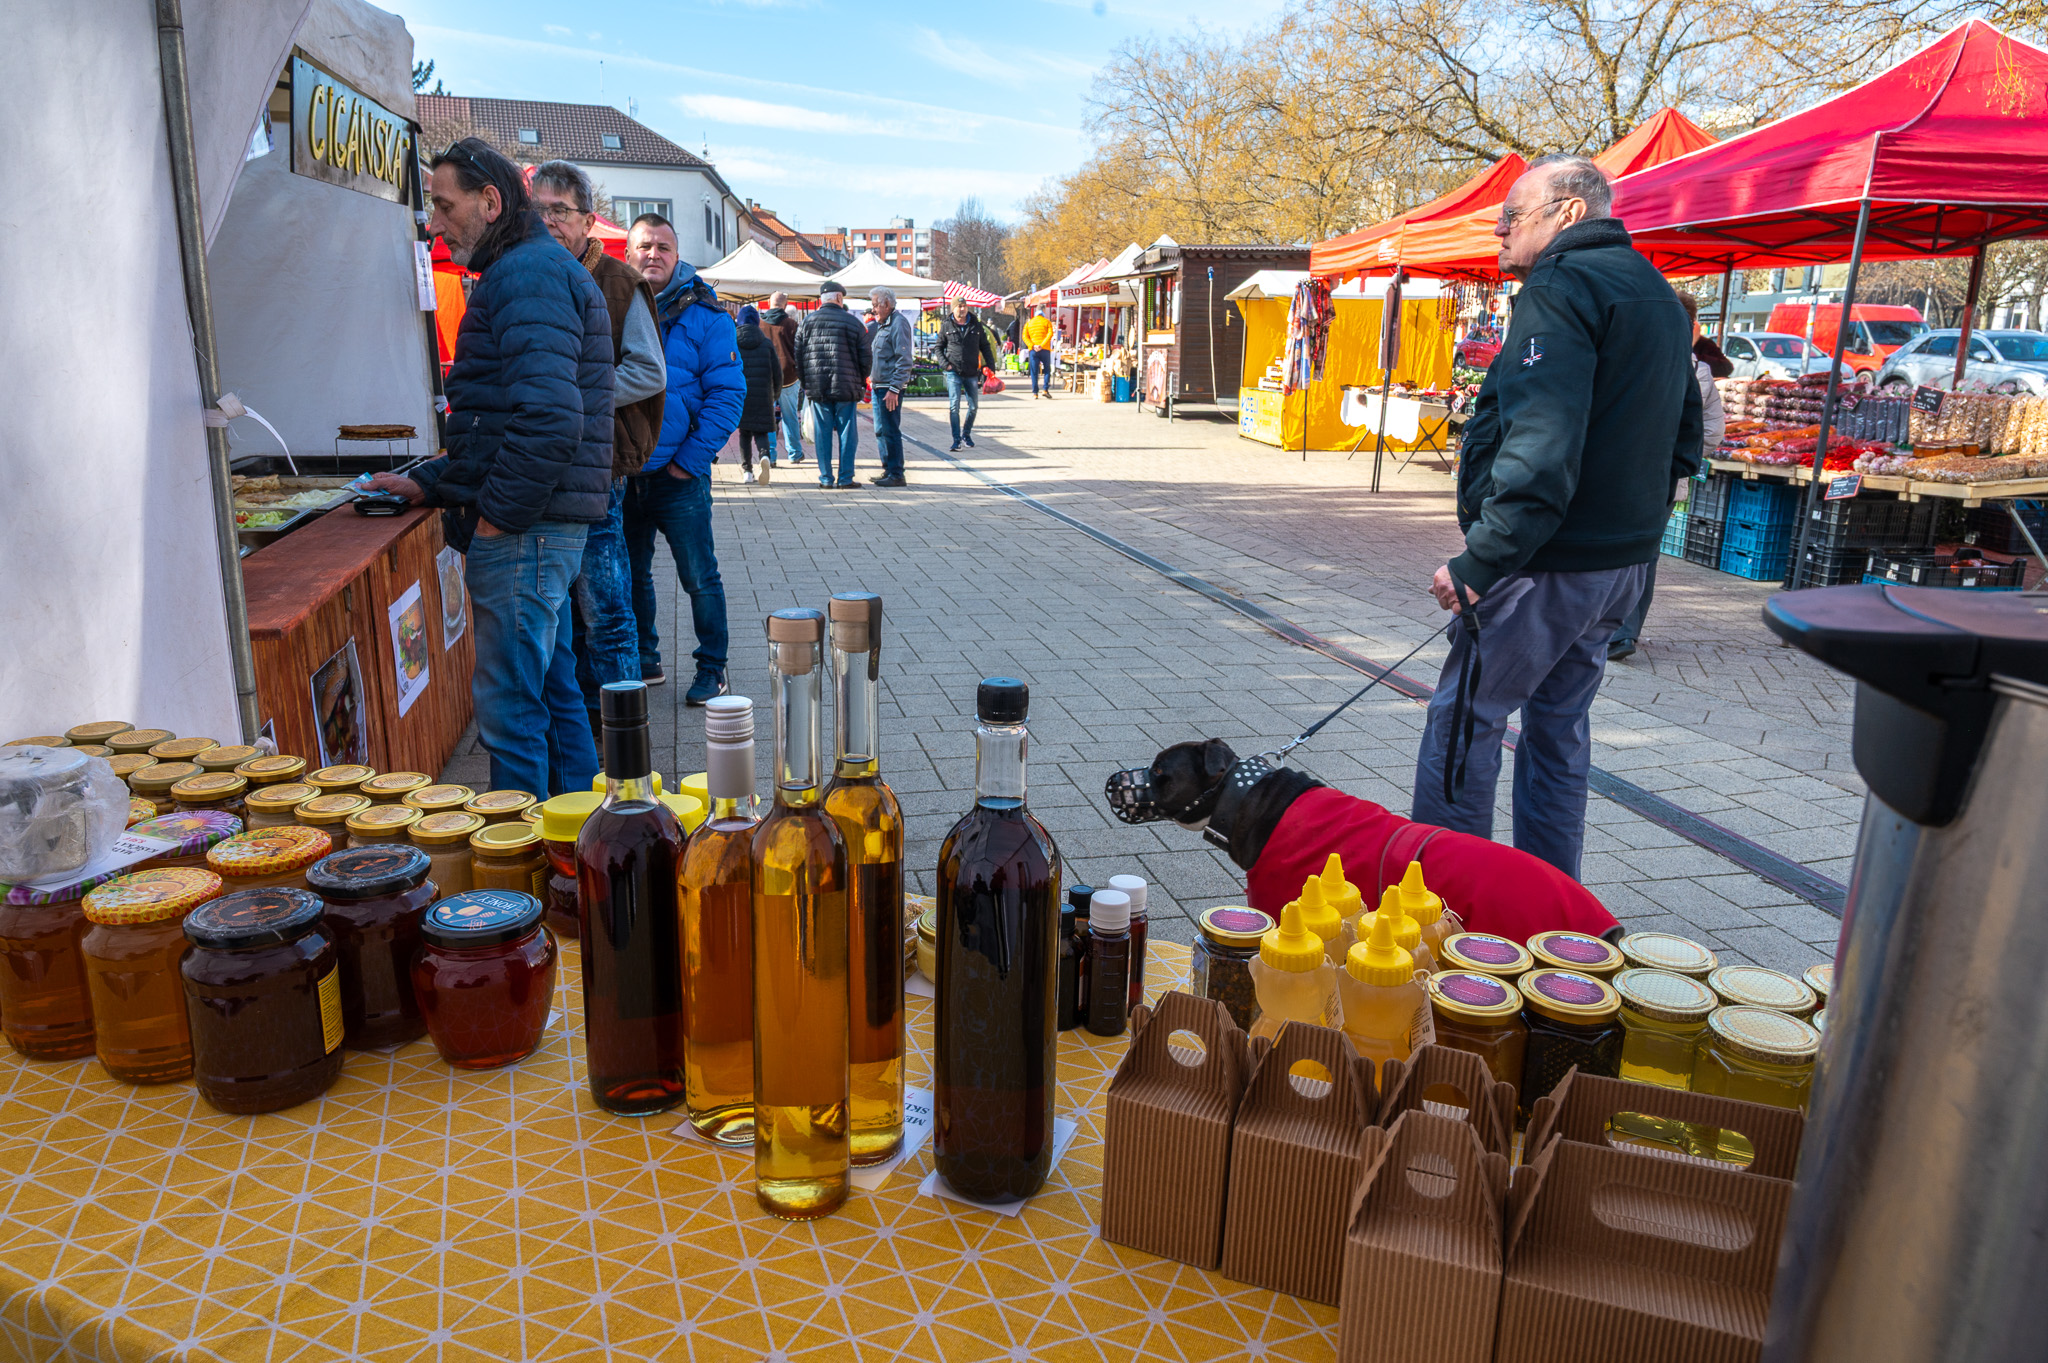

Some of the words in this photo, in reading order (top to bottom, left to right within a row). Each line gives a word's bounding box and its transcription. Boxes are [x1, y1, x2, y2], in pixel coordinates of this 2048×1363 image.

[477, 896, 517, 910] HONEY
[904, 1102, 930, 1115] SKL
[904, 1115, 927, 1126] ME
